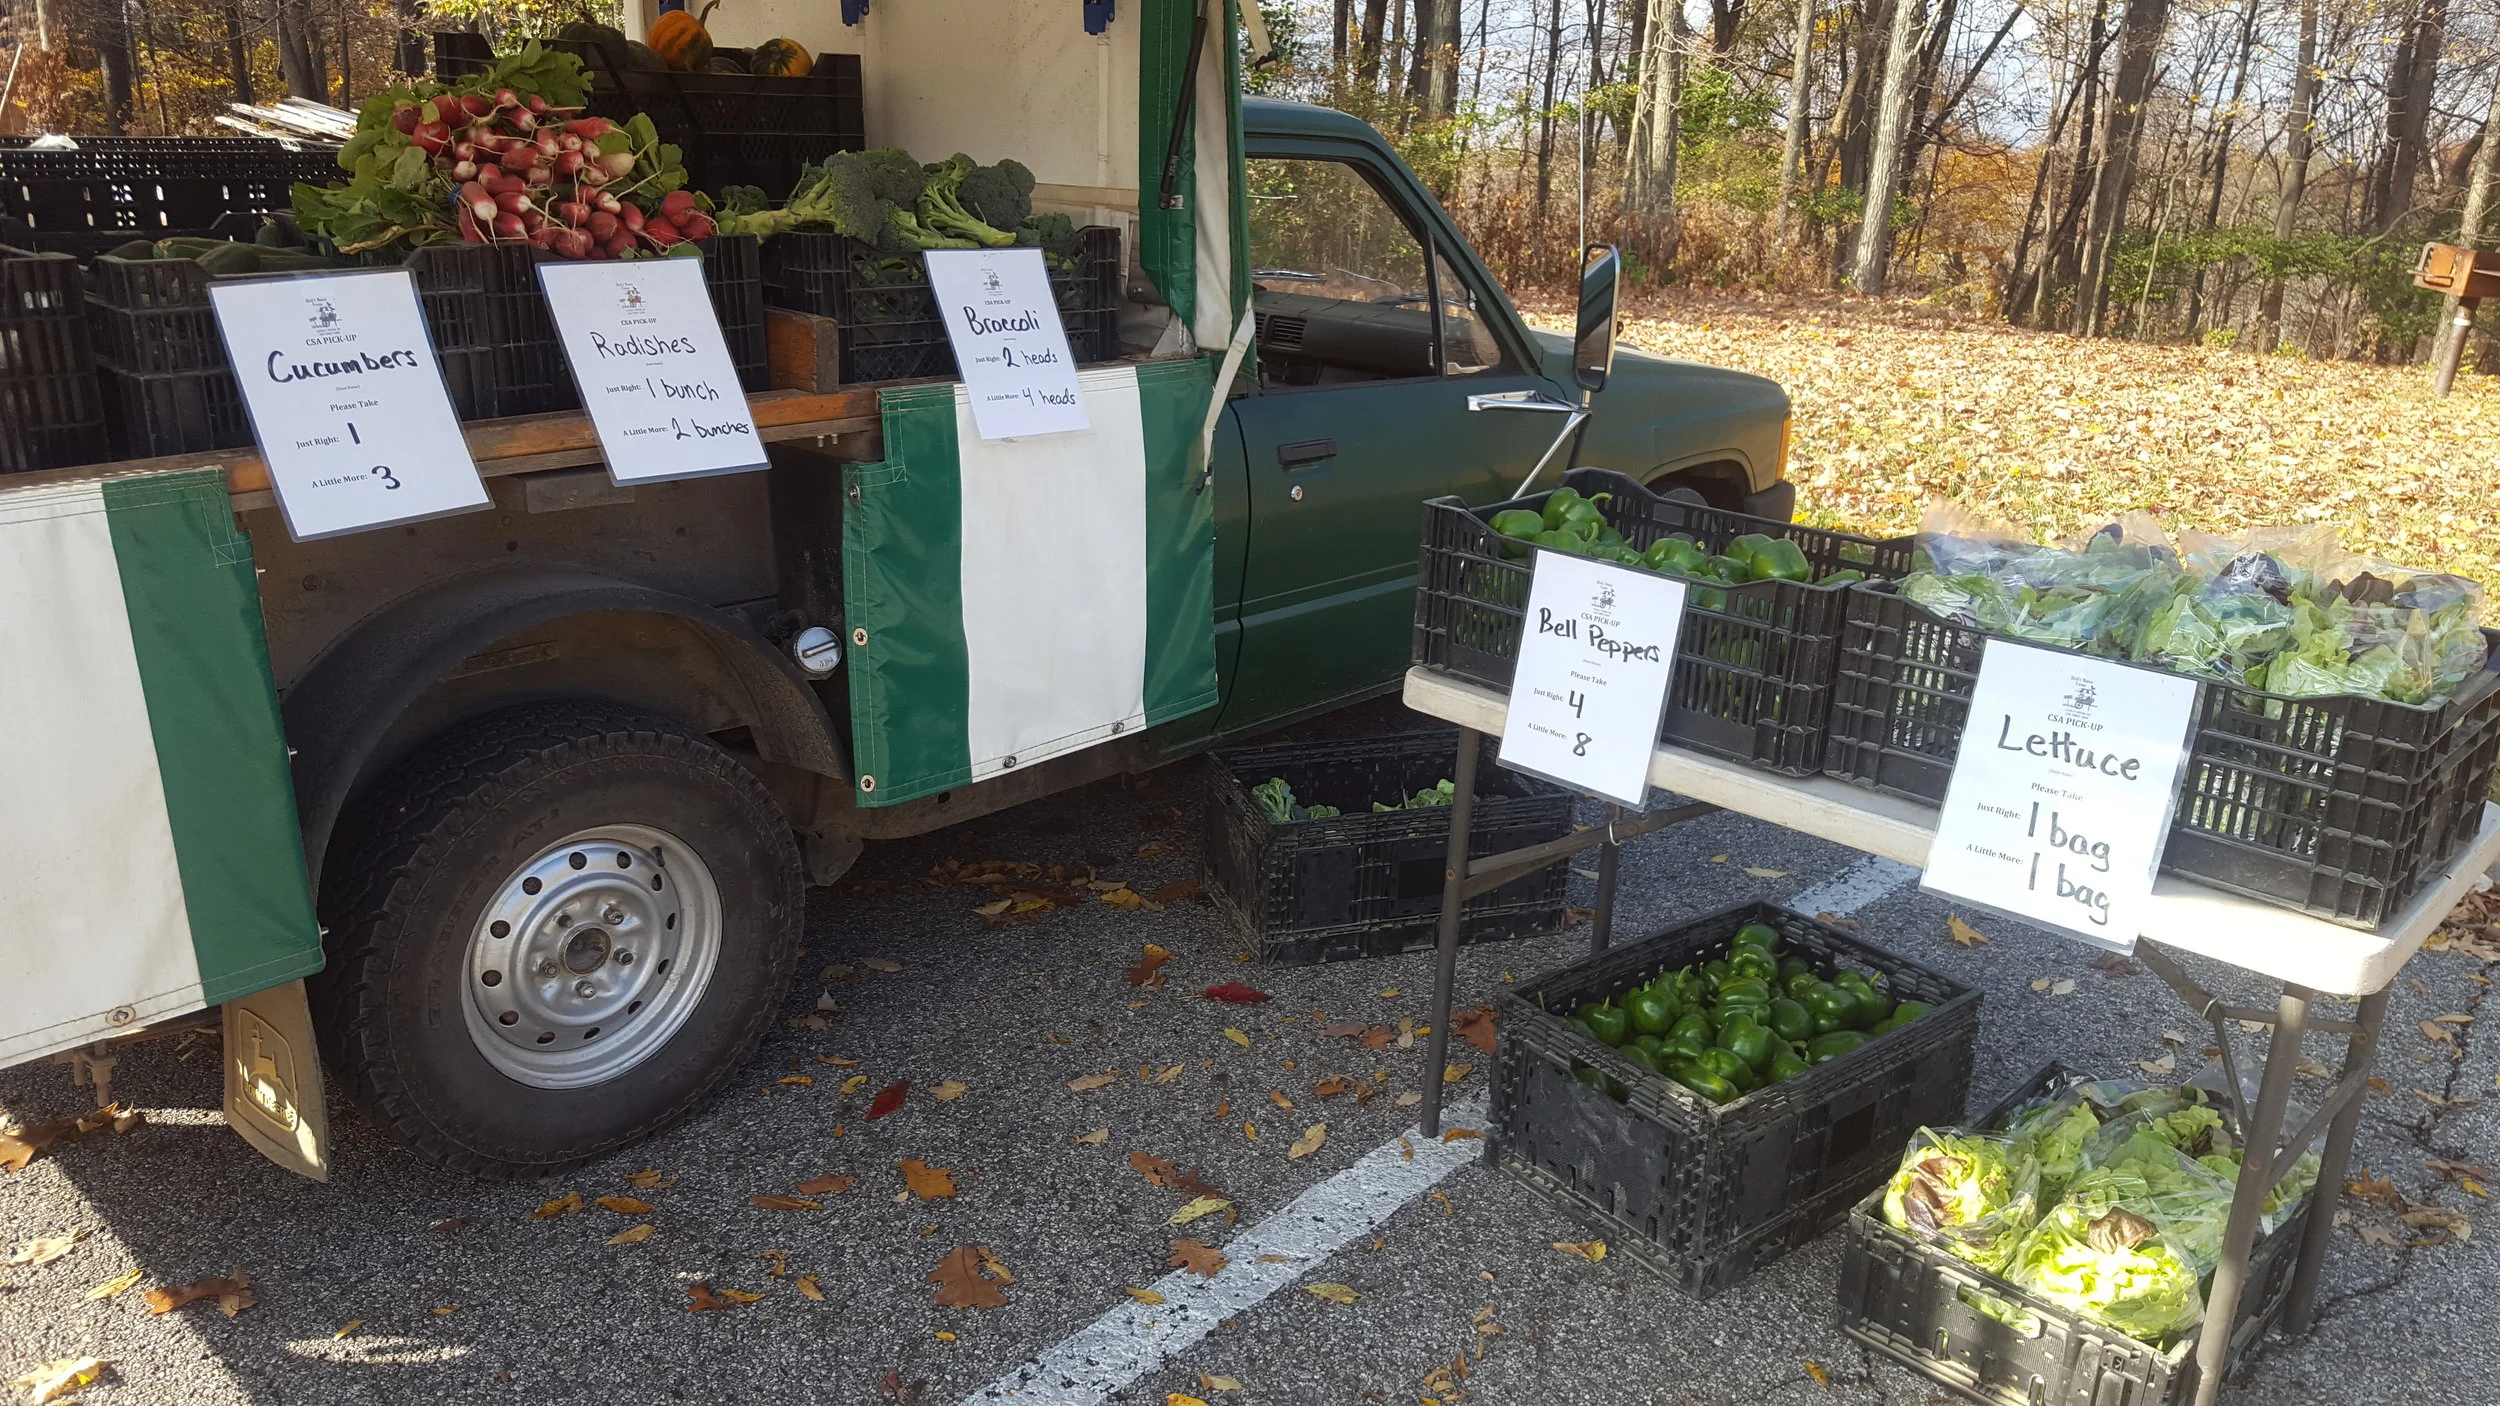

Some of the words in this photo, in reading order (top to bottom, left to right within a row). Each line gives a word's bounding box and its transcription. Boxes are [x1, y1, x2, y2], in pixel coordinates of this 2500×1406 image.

[964, 306, 1040, 335] Broccoli
[323, 335, 357, 344] PICK-UP
[590, 332, 696, 358] Radishes
[267, 350, 418, 382] Cucumbers
[1003, 347, 1020, 367] 2
[1021, 348, 1057, 365] heads
[606, 386, 620, 394] Just
[646, 378, 655, 398] 1
[661, 378, 719, 401] bunch
[1023, 388, 1034, 406] 4
[1039, 388, 1075, 405] heads
[330, 402, 357, 411] Please
[359, 399, 379, 408] Take
[296, 439, 312, 449] Just
[314, 436, 340, 447] Right:
[347, 422, 360, 444] 1
[671, 418, 691, 440] 2
[692, 418, 750, 439] bunches
[319, 476, 342, 486] Little
[343, 473, 368, 482] More:
[371, 465, 401, 490] 3
[1581, 613, 1592, 621] CSA
[1594, 615, 1620, 627] PICK-UP
[1539, 607, 1577, 639] Bell
[1589, 624, 1660, 662] Peppers
[1570, 671, 1590, 681] Please
[1592, 677, 1607, 686] Take
[1534, 688, 1545, 696] Just
[1547, 691, 1564, 702] Right:
[1569, 690, 1585, 718] 4
[2048, 714, 2064, 724] CSA
[2066, 718, 2103, 732] PICK-UP
[1533, 723, 1548, 733] Little
[1549, 729, 1567, 739] More:
[1573, 732, 1592, 756] 8
[1998, 714, 2140, 780] Lettuce
[2031, 783, 2060, 796] Please
[2062, 789, 2083, 801] Take
[1977, 802, 1994, 814] Just
[1996, 806, 2021, 820] Right:
[2028, 801, 2039, 837] 1
[2050, 811, 2110, 872] bag
[1974, 845, 1997, 858] Little
[1998, 852, 2023, 865] More:
[2029, 852, 2040, 890] 1
[2057, 863, 2110, 925] bag
